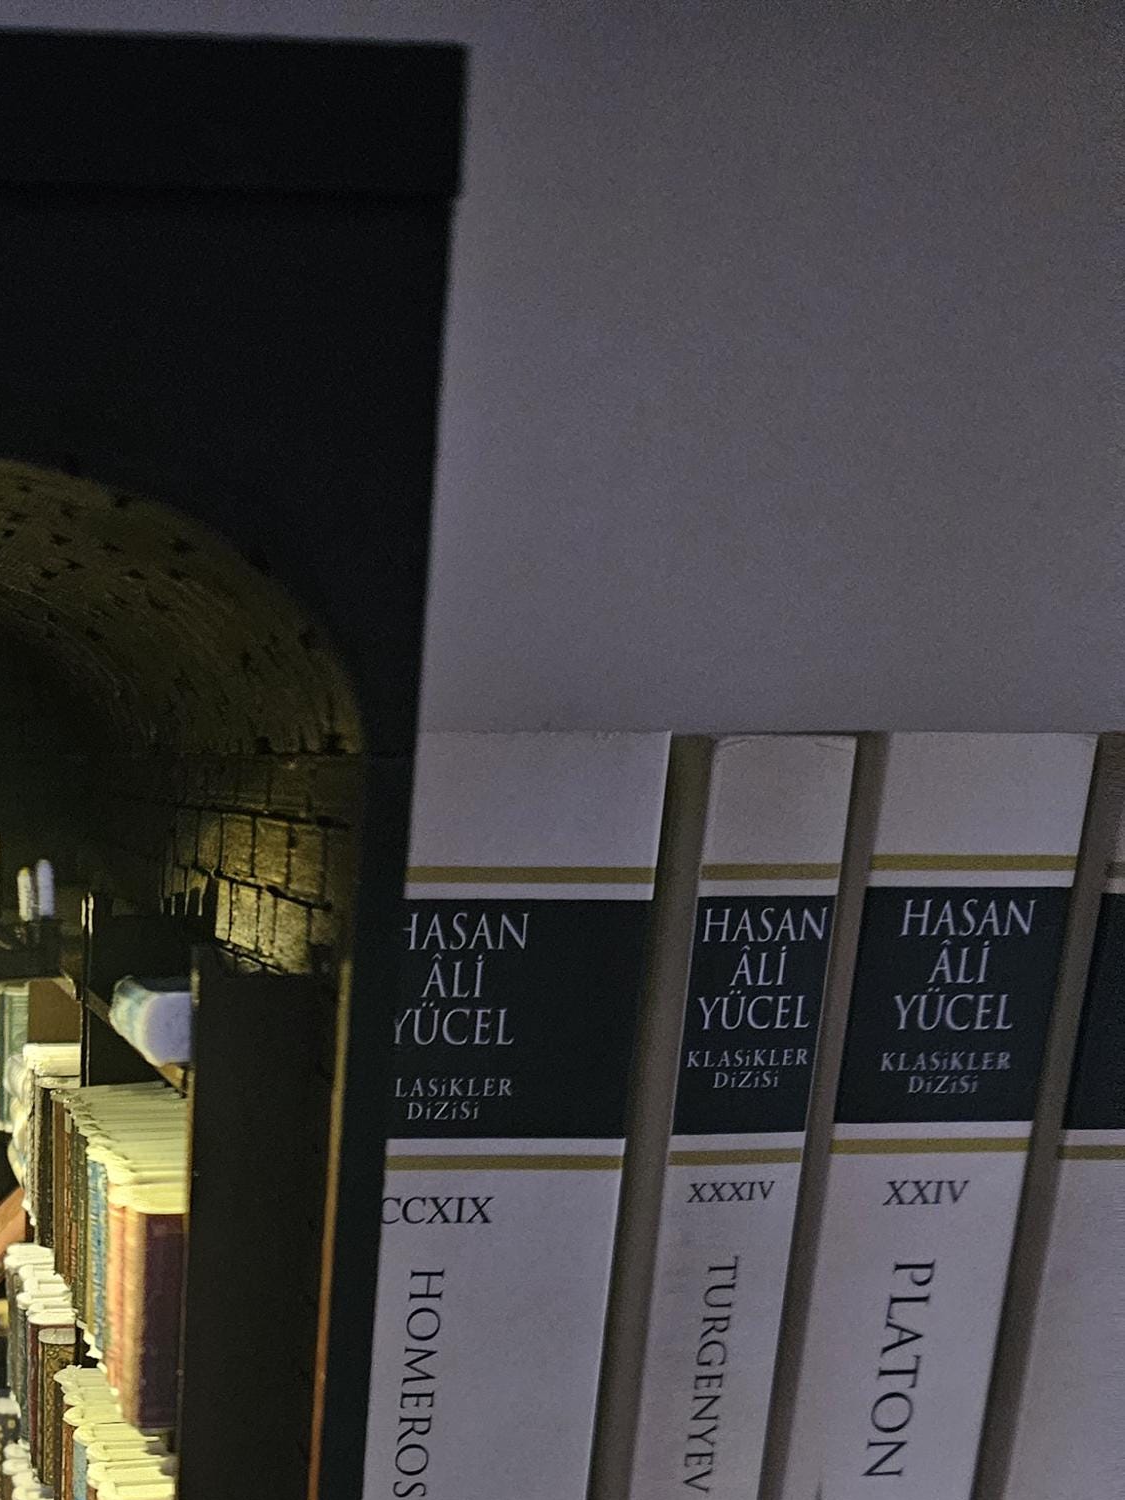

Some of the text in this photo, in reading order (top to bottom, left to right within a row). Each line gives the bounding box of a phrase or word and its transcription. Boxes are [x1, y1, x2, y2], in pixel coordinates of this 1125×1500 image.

[702, 906, 828, 943] HASAN
[900, 898, 1036, 937] HASAN
[420, 952, 484, 998] ÂLİ
[729, 944, 787, 987] ÂLİ
[927, 939, 990, 984] ÂLİ
[698, 989, 810, 1030] YÜCEL
[894, 987, 1013, 1031] YÜCEL
[686, 1180, 775, 1204] XXXIV
[882, 1179, 970, 1207] XXIV
[392, 1268, 445, 1498] HOMEROS
[682, 1255, 739, 1493] TURGENYEV
[862, 1261, 935, 1477] PLATON
